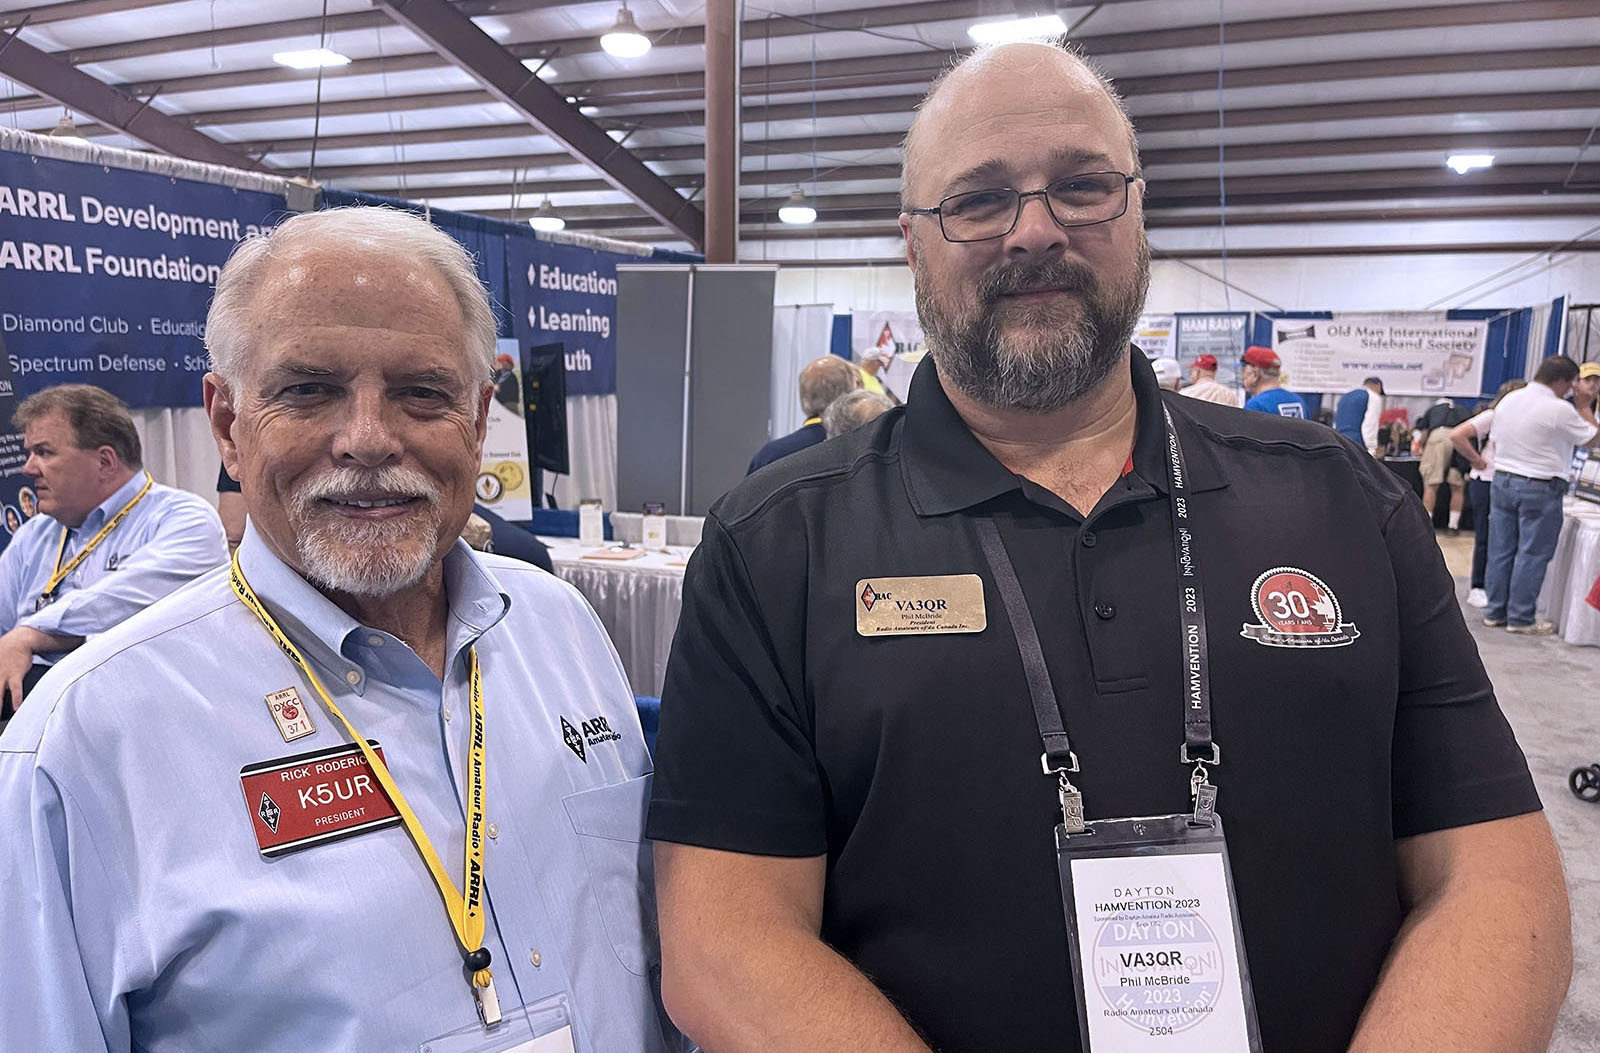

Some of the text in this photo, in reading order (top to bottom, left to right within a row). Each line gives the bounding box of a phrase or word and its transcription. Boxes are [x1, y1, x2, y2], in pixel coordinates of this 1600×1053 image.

[0, 186, 76, 222] ARRL
[80, 196, 240, 241] Development
[0, 241, 220, 284] ARRL Foundation
[539, 264, 618, 296] Education
[3, 314, 206, 336] Diamond Club Educatio
[539, 306, 610, 339] Learning
[1327, 325, 1478, 338] Old Man International
[1361, 338, 1477, 353] Sideband Society
[8, 354, 94, 375] Spectrum
[99, 355, 166, 372] Defense
[564, 349, 592, 371] uth
[1168, 432, 1184, 489] HAMVENTION
[1176, 497, 1187, 519] 2023
[876, 592, 892, 601] RAC
[896, 599, 948, 612] VA3QR
[1185, 587, 1197, 613] 2023
[1268, 590, 1310, 619] 30
[1190, 624, 1203, 710] HAMVENTION
[273, 697, 300, 712] DXCC
[274, 692, 291, 701] ARRL
[287, 720, 307, 735] 371
[473, 708, 483, 750] ARRL
[281, 756, 369, 783] RICK RODERIC
[297, 774, 375, 810] K5UR
[473, 758, 482, 810] Amateur
[314, 807, 367, 828] PRESIDENT
[472, 812, 482, 849] Radio
[468, 858, 481, 910] ARRL
[1113, 886, 1175, 898] DAYTON
[1095, 898, 1201, 912] HAMVENTION 2023
[1112, 919, 1196, 941] DAYTON
[1120, 951, 1183, 968] VA3QR
[1120, 975, 1191, 987] Phil McBride
[1143, 988, 1182, 1005] 2023
[1103, 1005, 1214, 1017] Radio Amateurs of Canada
[1149, 1026, 1174, 1036] 2504
